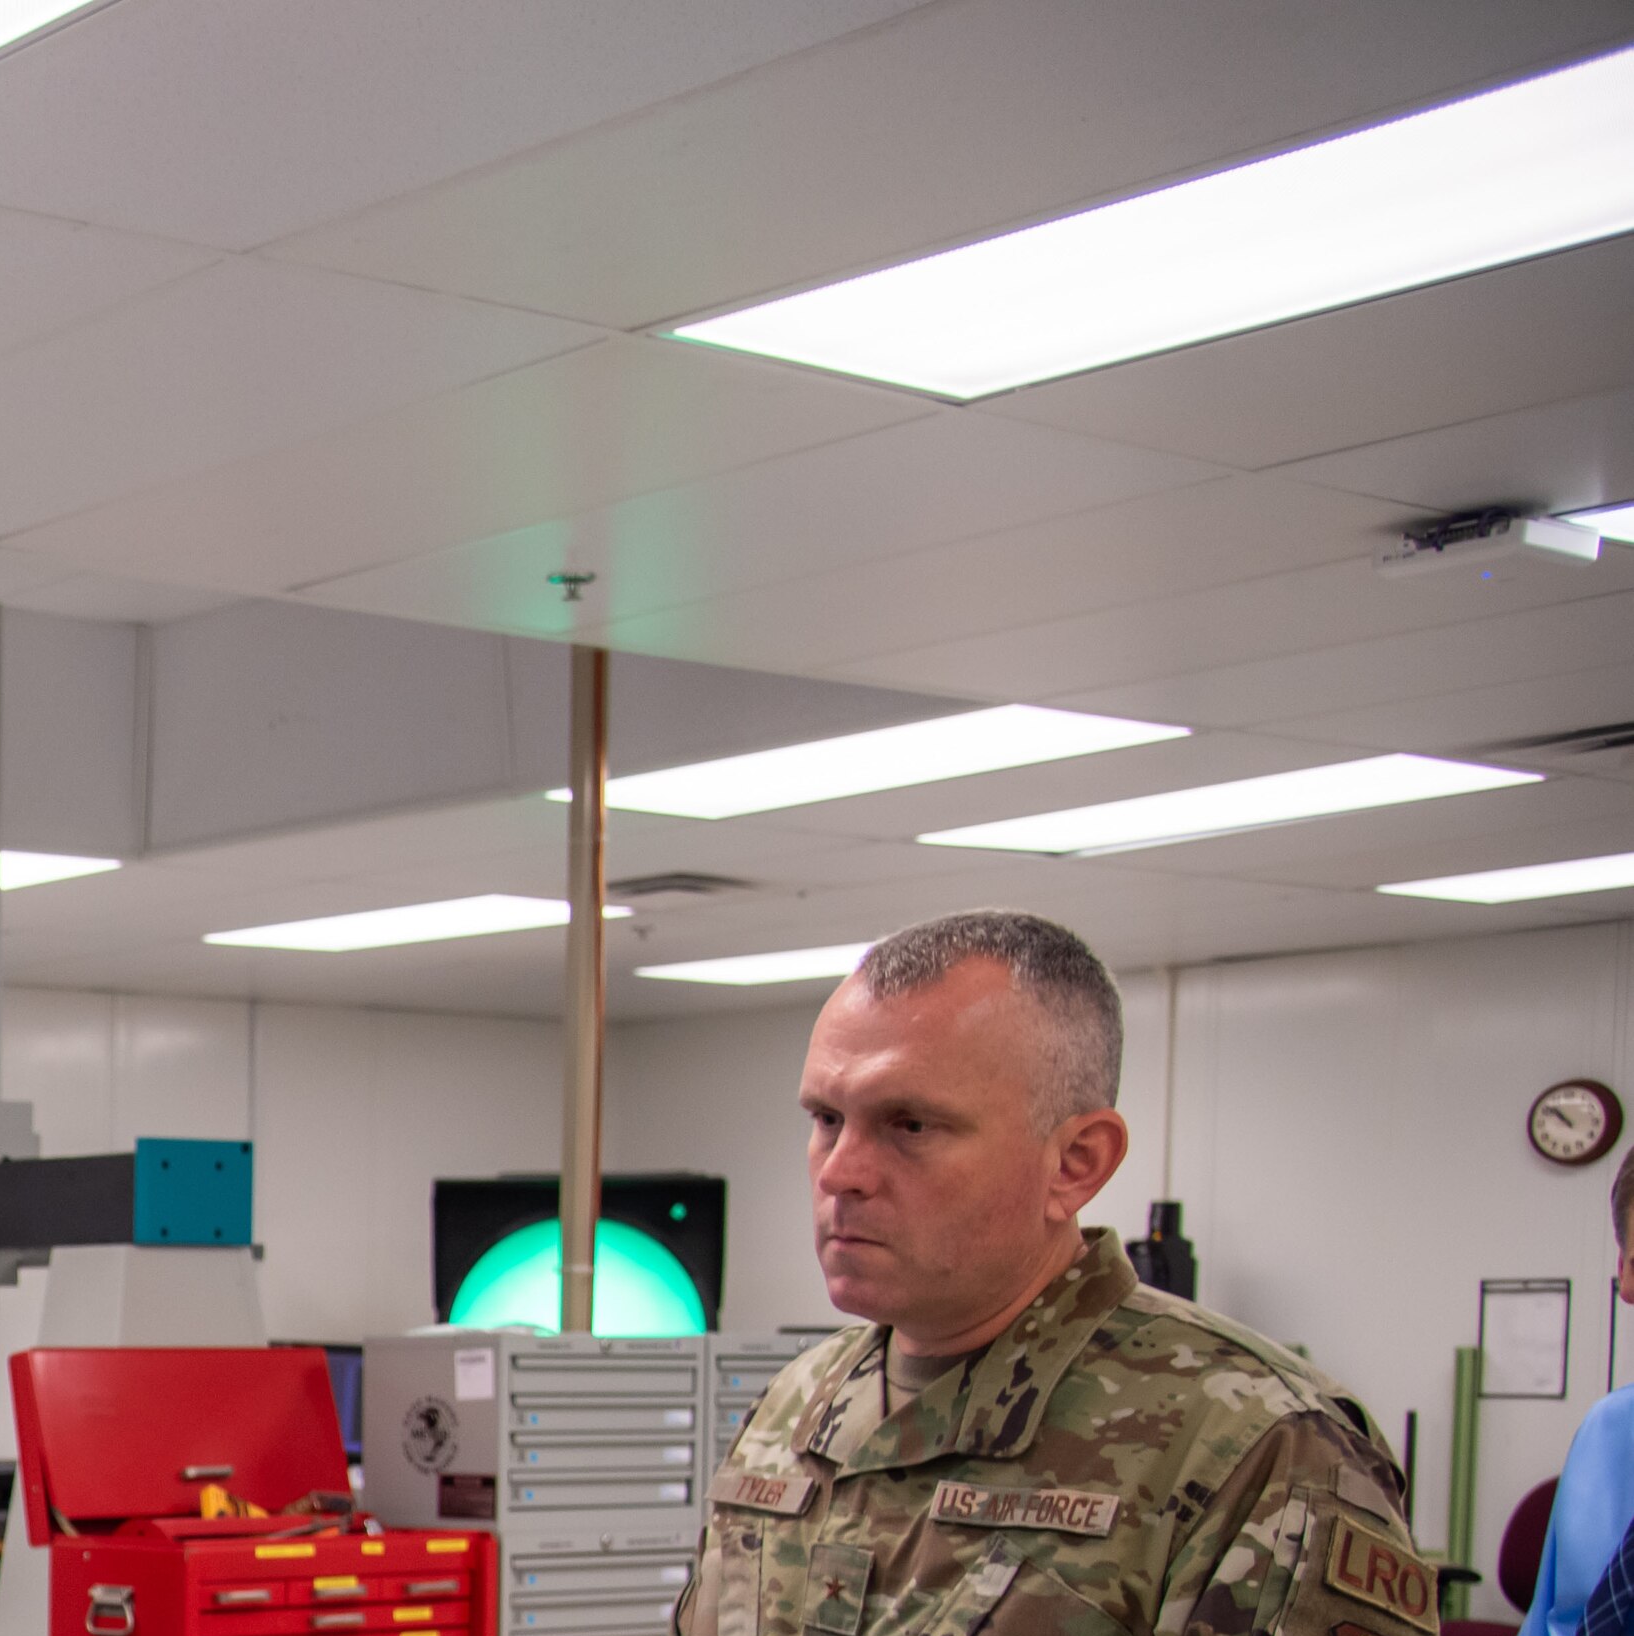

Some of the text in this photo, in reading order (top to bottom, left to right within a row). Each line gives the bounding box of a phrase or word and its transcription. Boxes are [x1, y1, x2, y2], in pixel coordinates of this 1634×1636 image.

[736, 1476, 788, 1507] TYLER
[937, 1487, 1104, 1528] US AIR FORCE
[1337, 1530, 1429, 1617] LRO
